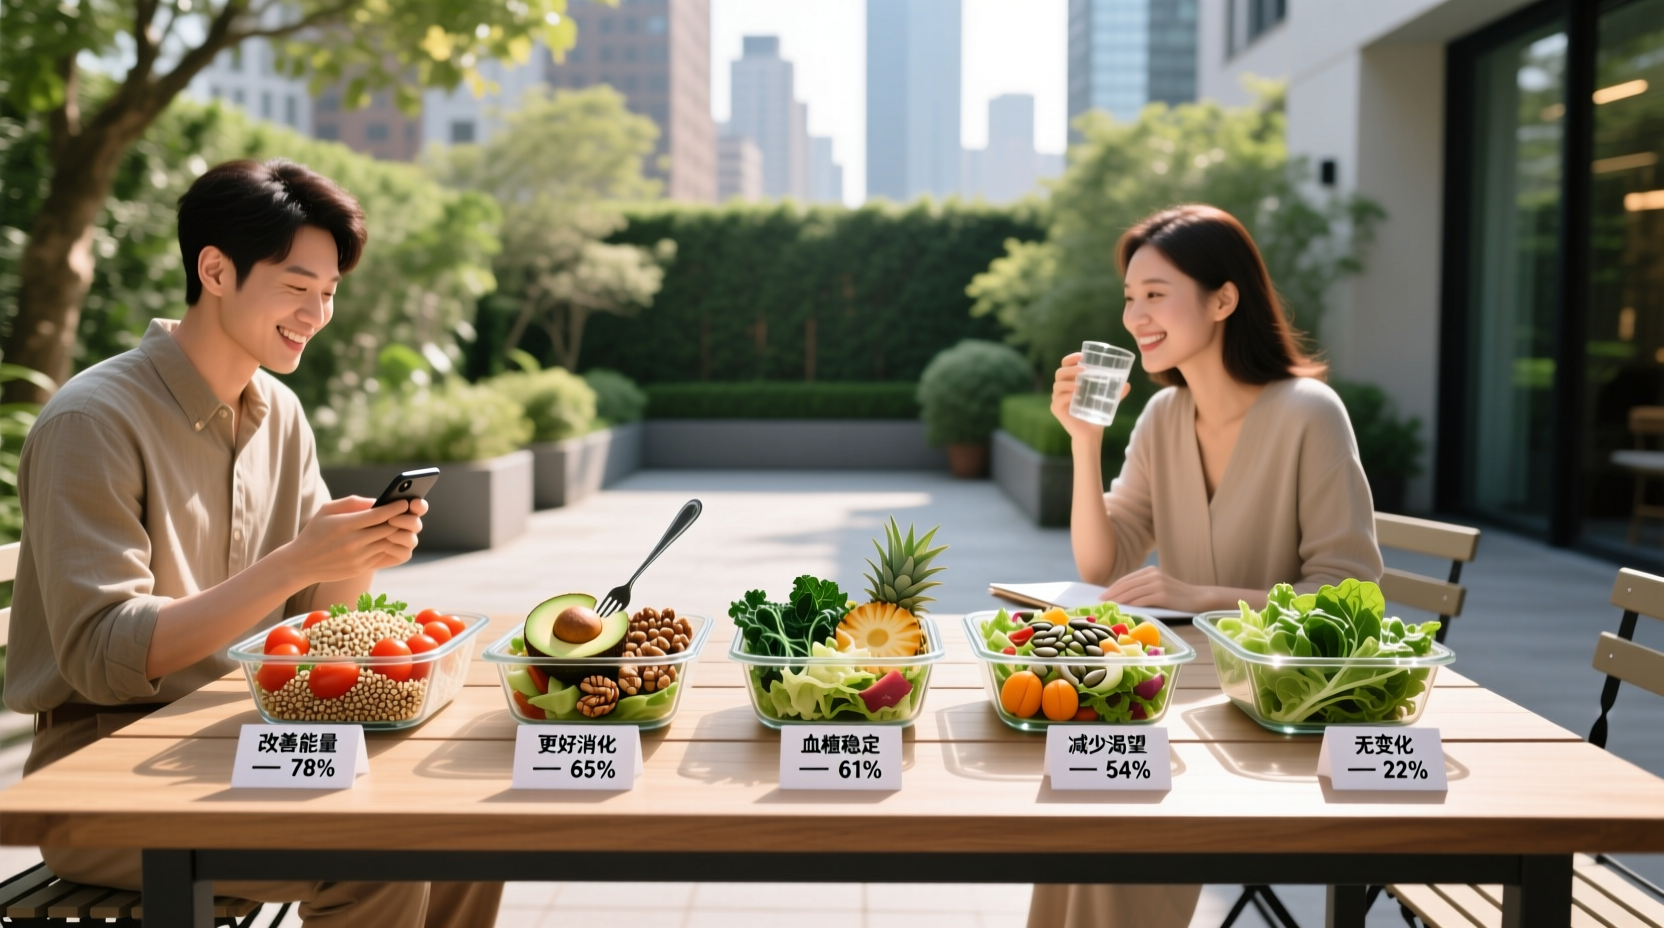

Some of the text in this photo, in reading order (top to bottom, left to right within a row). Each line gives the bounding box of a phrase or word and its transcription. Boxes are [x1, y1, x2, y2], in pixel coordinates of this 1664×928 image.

[258, 732, 337, 754] 改善能量
[538, 734, 617, 755] 更好消化
[1354, 734, 1414, 755] 无变化
[292, 759, 336, 777] 78%
[571, 760, 616, 779] 65%
[838, 760, 882, 779] 61%
[1106, 760, 1151, 779] 54%
[1383, 760, 1428, 779] 22%
